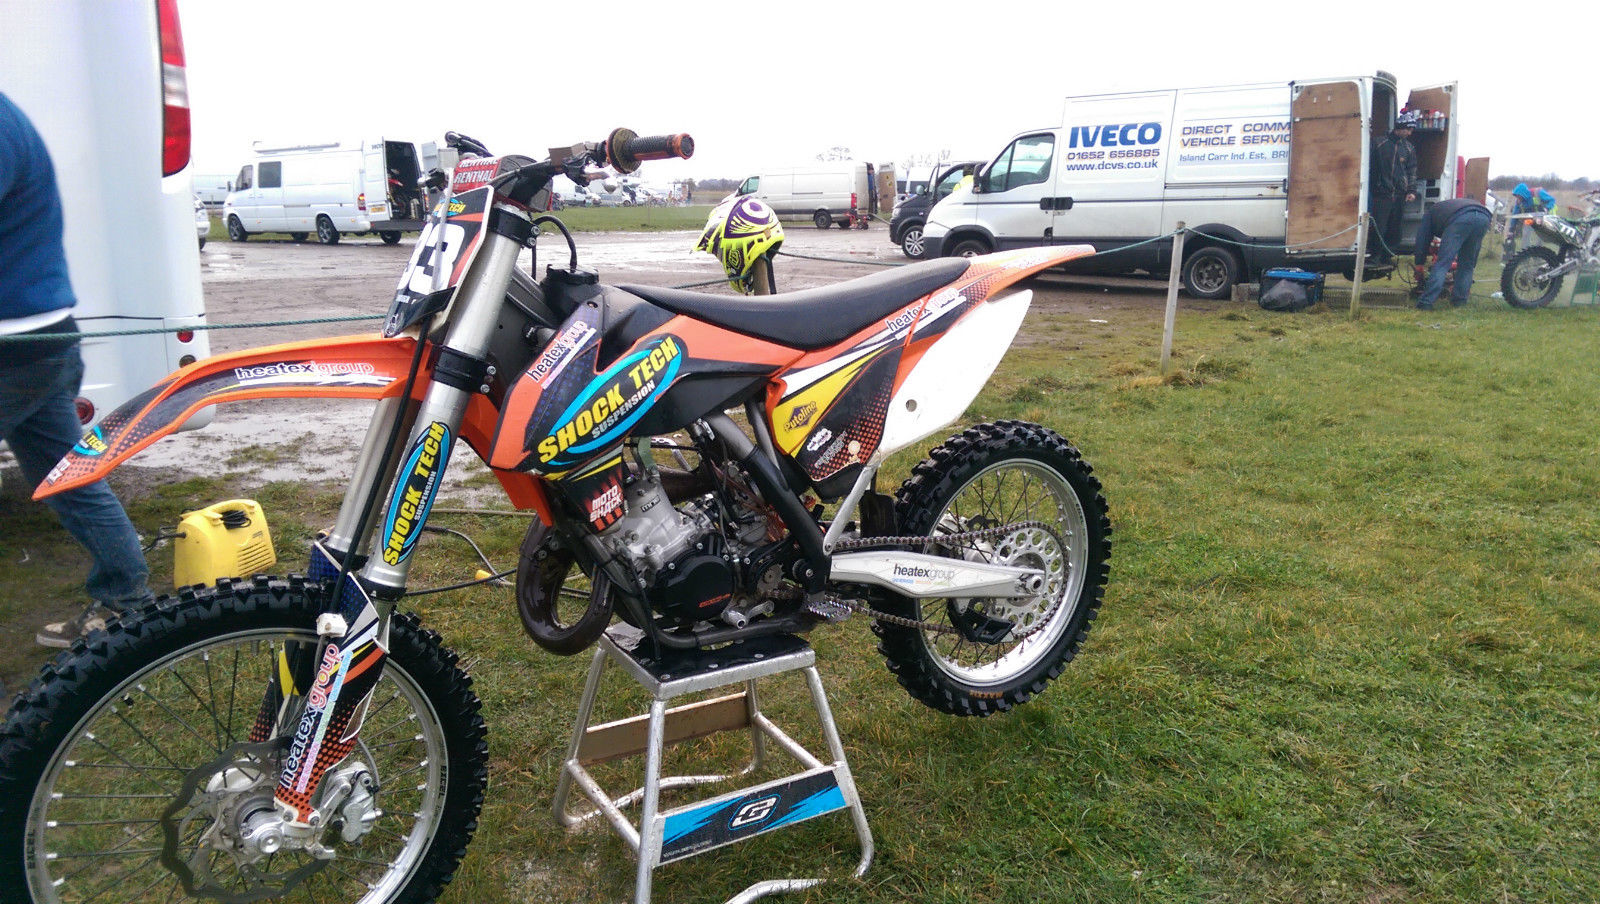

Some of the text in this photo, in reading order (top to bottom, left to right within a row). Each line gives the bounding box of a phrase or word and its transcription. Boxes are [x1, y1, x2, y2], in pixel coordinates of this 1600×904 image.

[1069, 122, 1163, 148] IVECO
[1182, 124, 1232, 135] DIRECT
[1181, 136, 1236, 147] VEHICLE
[1067, 148, 1160, 160] 01652 656885
[1179, 153, 1205, 162] Island
[1207, 153, 1229, 161] Carr
[1067, 159, 1158, 171] www.dcvs.co.uk
[453, 169, 493, 183] RENTHAL
[537, 336, 680, 464] SHOCK TECH
[591, 380, 656, 439] SUSPENSION
[383, 421, 446, 566] SHOCK TECH
[414, 471, 437, 521] SUSPENSION
[592, 485, 618, 510] MOTO
